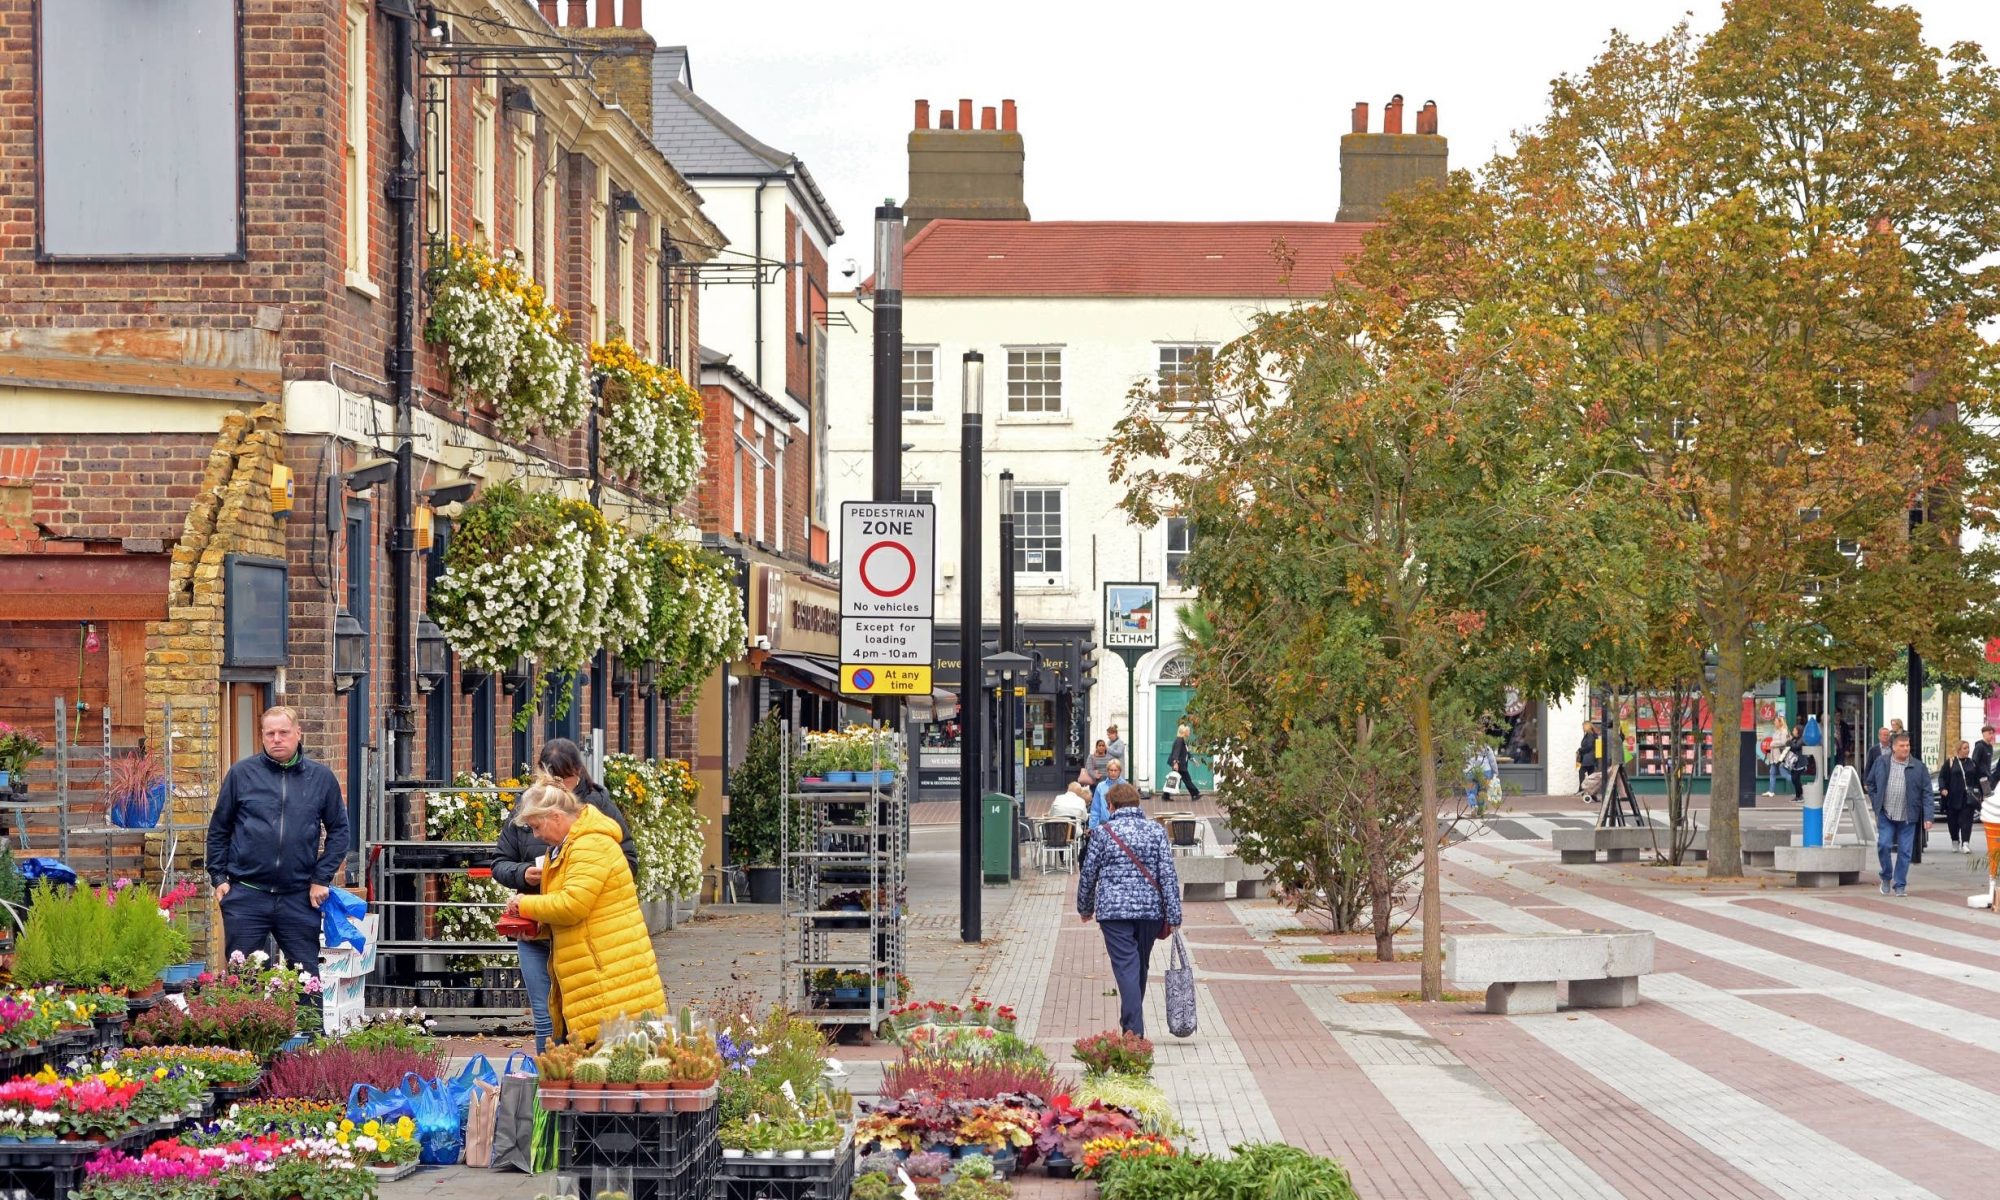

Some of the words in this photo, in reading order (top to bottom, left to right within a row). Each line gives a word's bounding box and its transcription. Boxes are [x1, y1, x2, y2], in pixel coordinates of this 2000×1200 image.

[344, 398, 358, 432] THE
[851, 508, 925, 518] PEDESTRIAN
[862, 521, 913, 535] ZONE
[853, 602, 869, 611] No
[873, 602, 919, 612] vehicles
[855, 622, 895, 632] Except
[900, 622, 916, 632] for
[865, 635, 906, 646] loading
[1109, 634, 1153, 644] ELTHAM
[938, 659, 961, 669] Jewe
[885, 670, 898, 679] At
[901, 672, 919, 681] any
[891, 680, 914, 690] time
[991, 805, 1001, 814] 14
